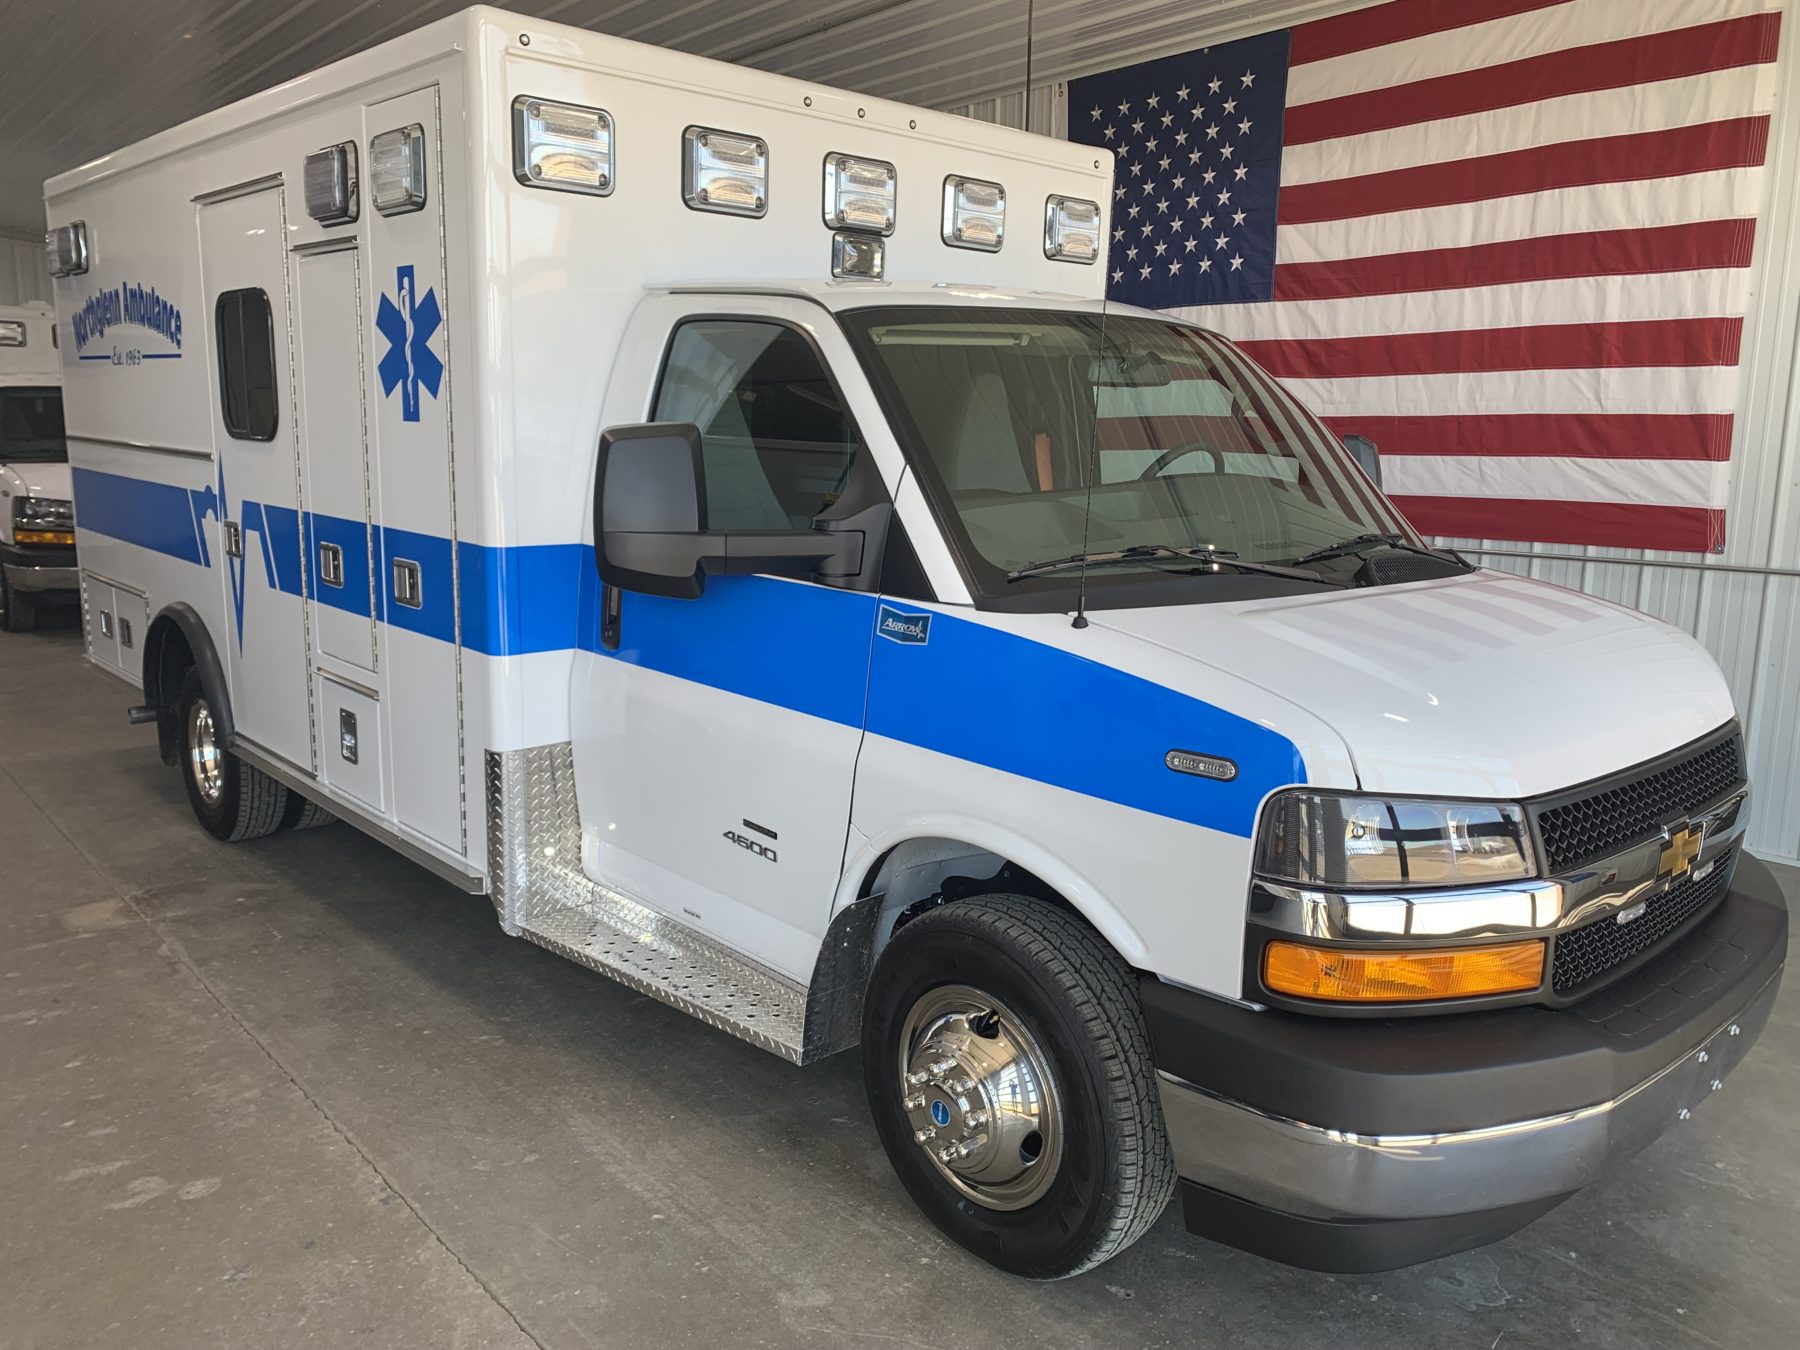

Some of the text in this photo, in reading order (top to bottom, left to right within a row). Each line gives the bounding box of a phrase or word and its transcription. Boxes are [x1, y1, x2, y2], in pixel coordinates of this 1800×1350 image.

[72, 280, 182, 352] Northglenn Ambulance
[125, 347, 141, 366] 1963
[882, 617, 922, 635] ARROW
[722, 830, 778, 864] 4500
